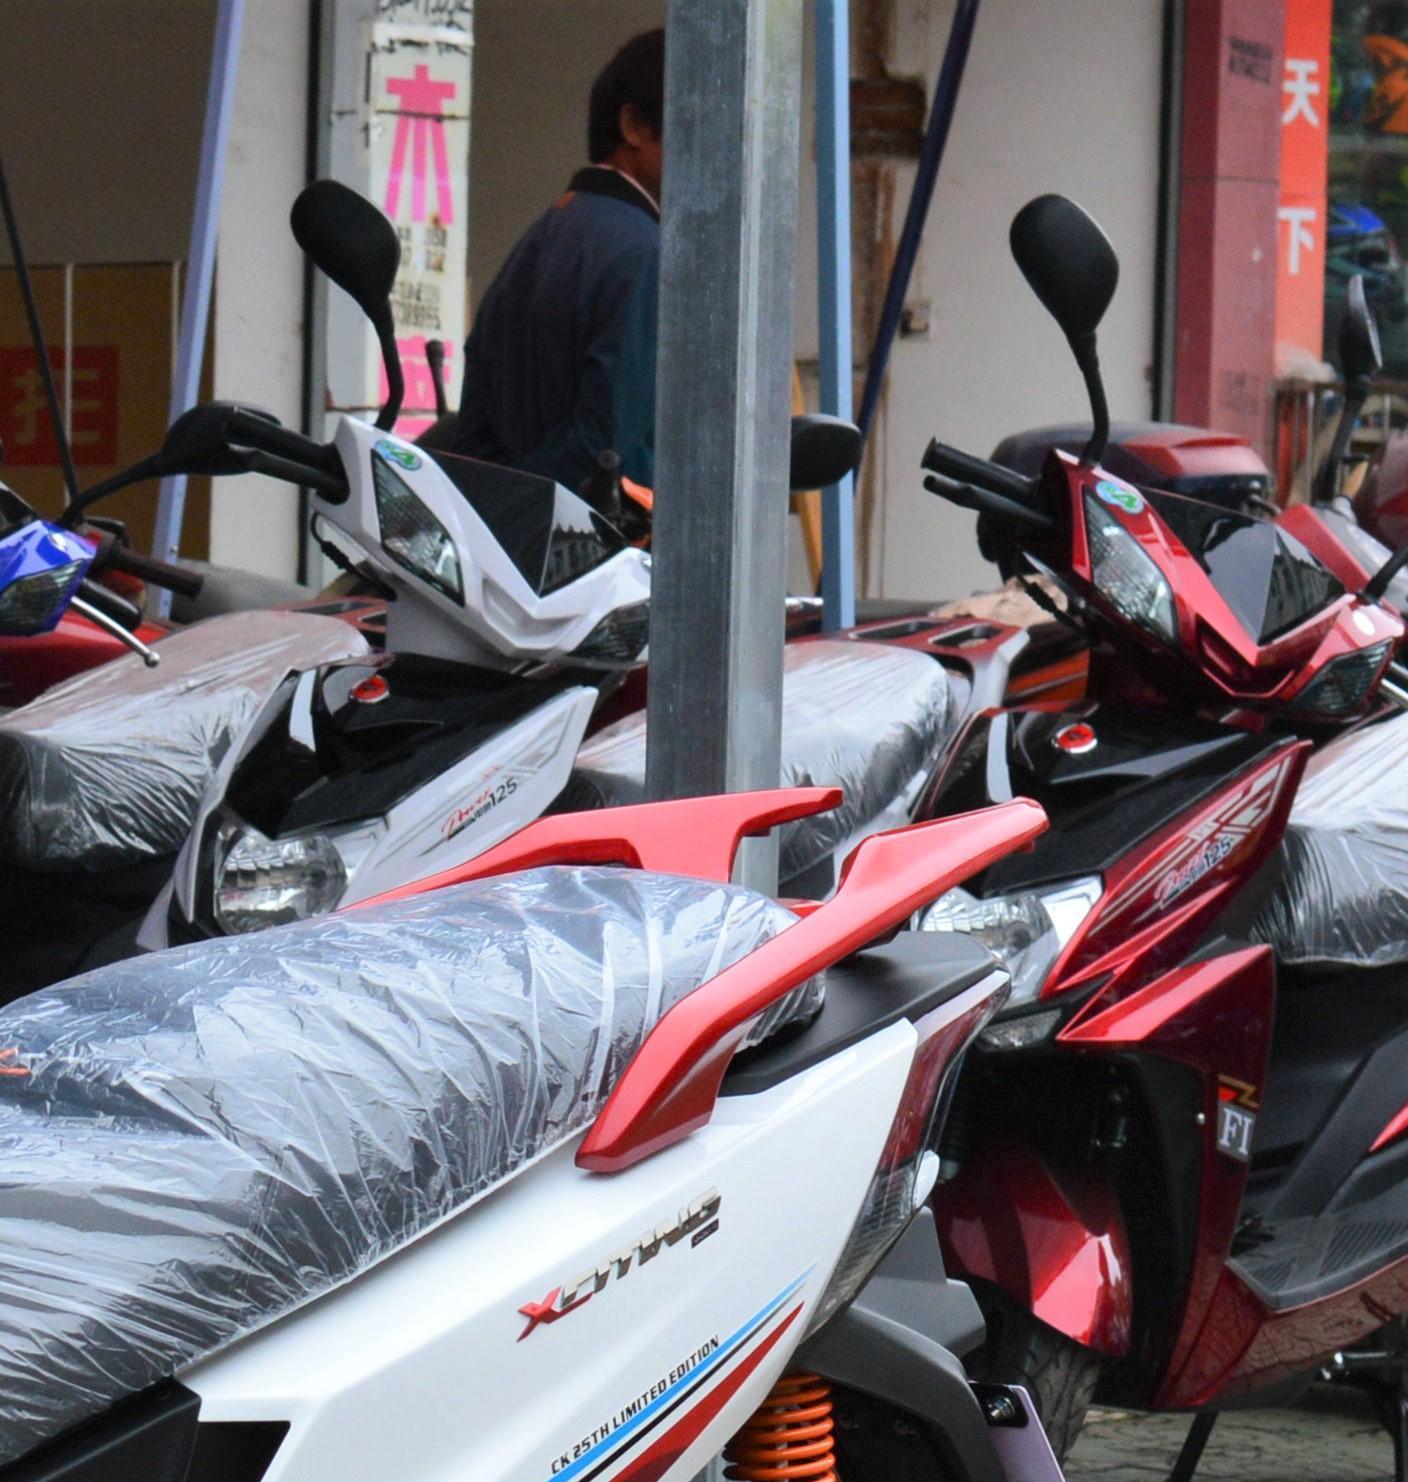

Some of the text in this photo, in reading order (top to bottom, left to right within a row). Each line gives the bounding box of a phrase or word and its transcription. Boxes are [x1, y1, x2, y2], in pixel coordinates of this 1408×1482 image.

[488, 776, 518, 807] 125
[1203, 836, 1233, 867] 125
[1219, 1106, 1253, 1156] FI
[551, 1334, 720, 1475] CK 25TH LIMITED EDITION
